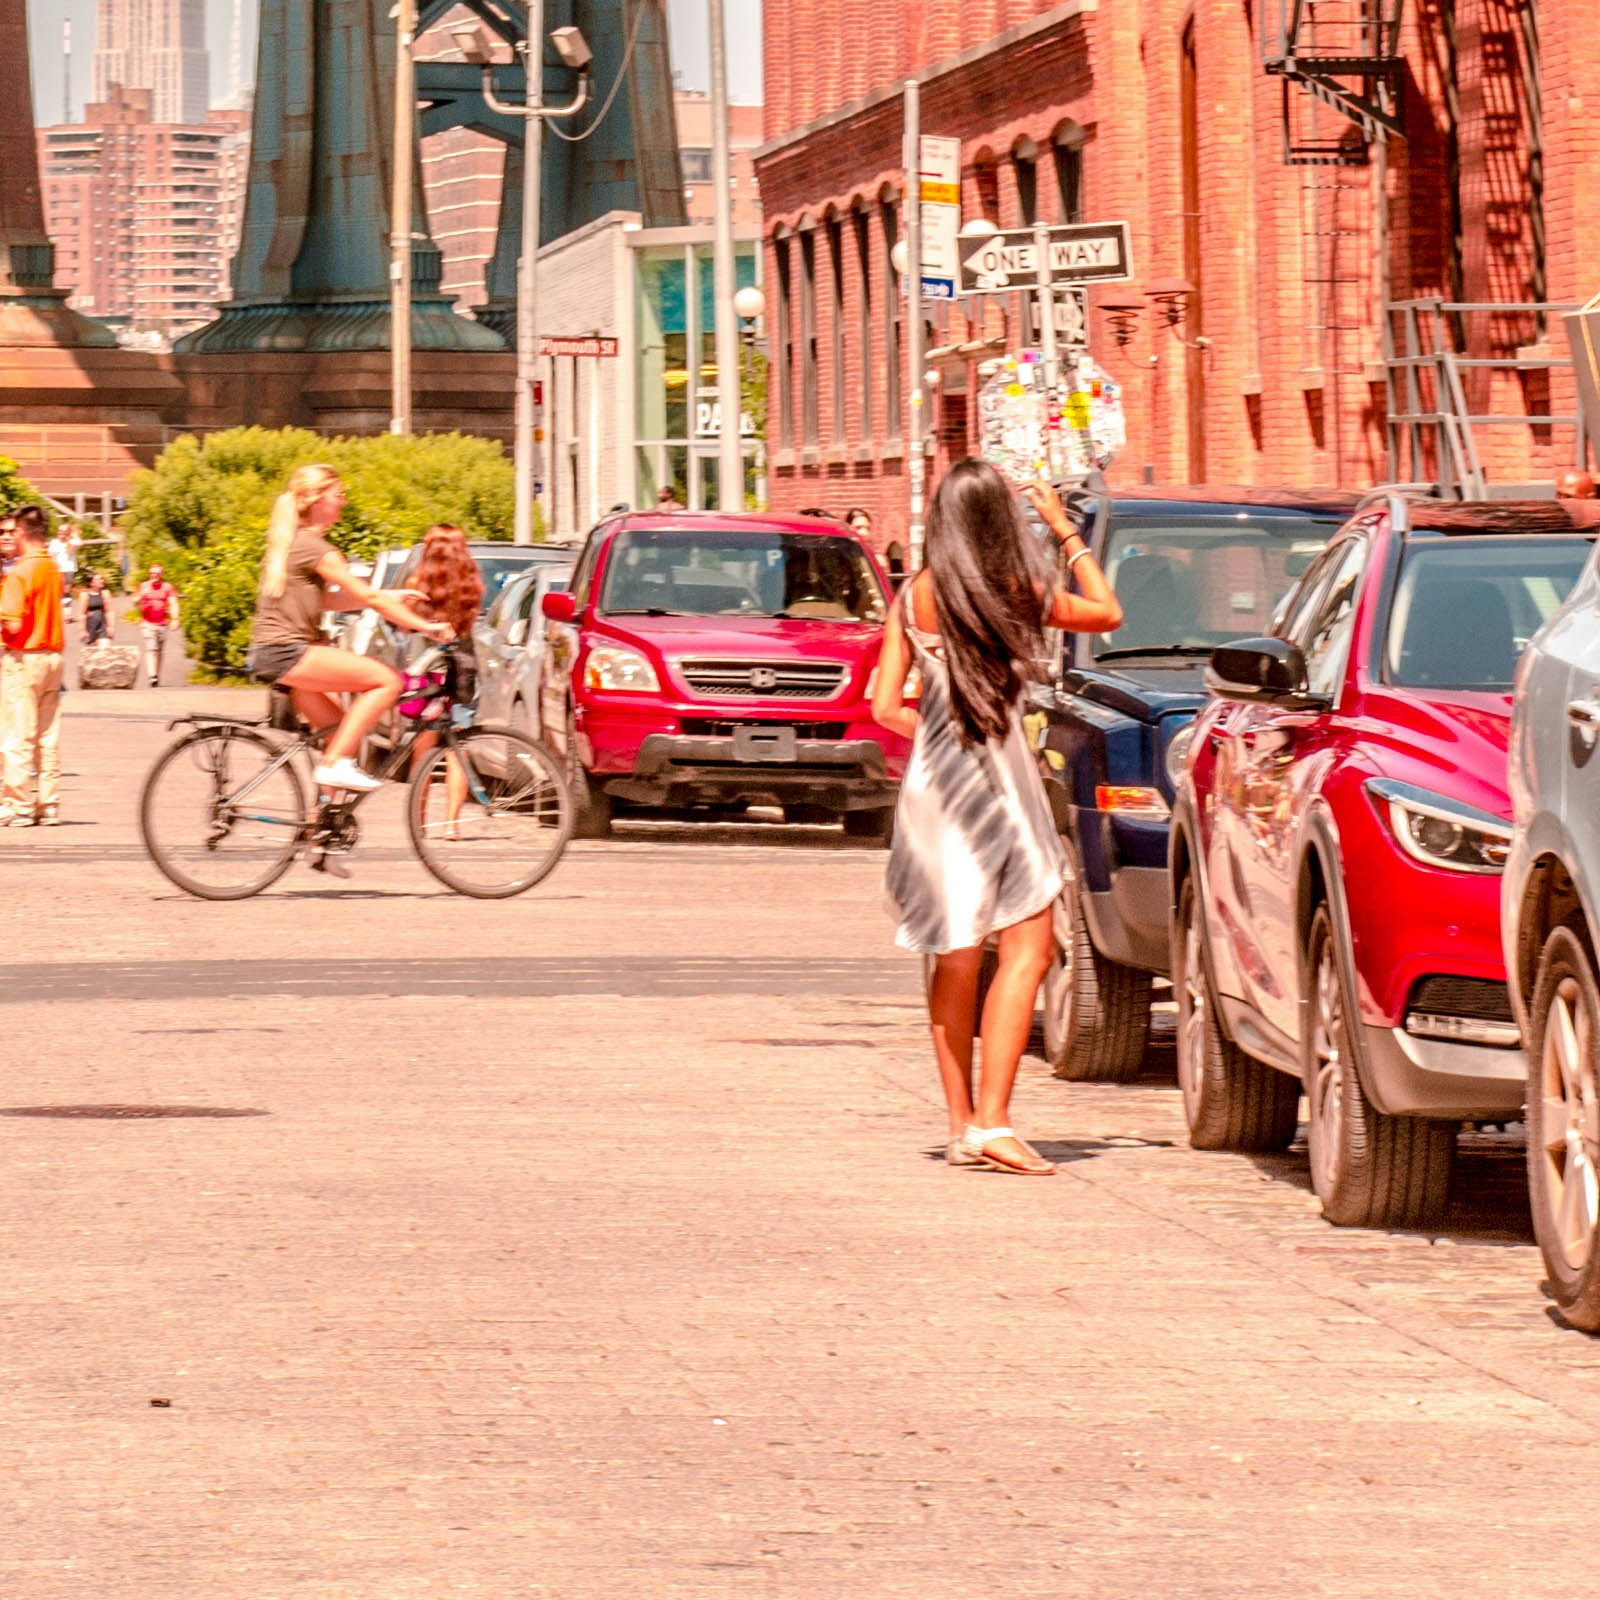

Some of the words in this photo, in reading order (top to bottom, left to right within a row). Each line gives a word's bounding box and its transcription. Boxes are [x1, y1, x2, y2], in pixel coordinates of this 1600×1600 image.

[983, 248, 1032, 272] ONE
[1054, 241, 1105, 266] WAY
[540, 339, 599, 355] Plymouth
